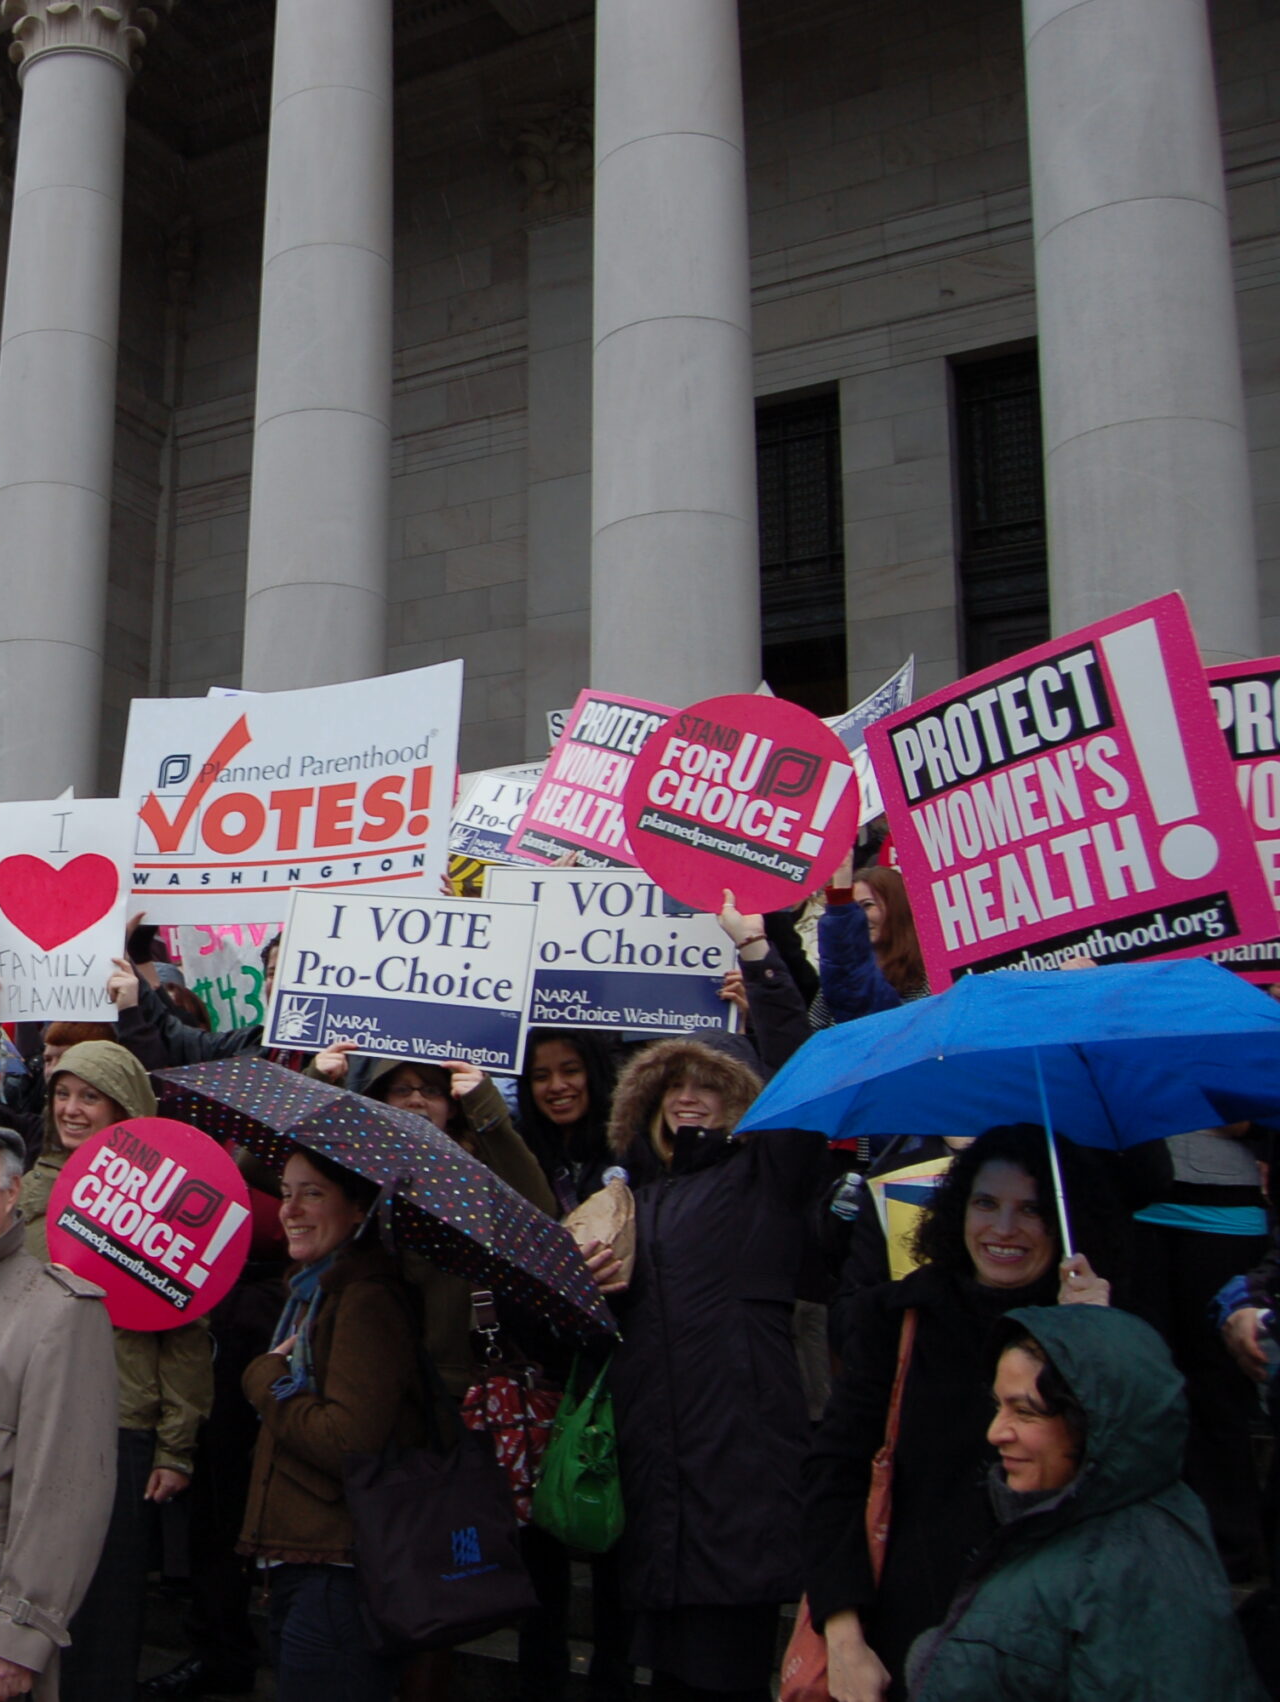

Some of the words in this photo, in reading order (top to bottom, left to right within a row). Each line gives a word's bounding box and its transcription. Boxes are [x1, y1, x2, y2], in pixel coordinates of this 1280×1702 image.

[572, 701, 669, 755] PROTEC
[674, 714, 740, 752] STAND
[892, 649, 1101, 800] PROTECT
[299, 735, 430, 777] Parenthood
[552, 743, 635, 797] WOMEN
[910, 735, 1130, 872] WOMEN'S
[49, 812, 73, 853] I
[638, 811, 807, 882] plannedparenthood.org
[133, 854, 425, 885] WASHINGTON
[570, 881, 694, 918] VOT
[327, 905, 347, 939] I
[370, 906, 491, 950] VOTE
[539, 928, 721, 969] o-Choice
[292, 950, 513, 1002] Pro-Choice
[534, 989, 591, 1004] NARAL
[326, 1013, 381, 1031] NARAL
[533, 1003, 620, 1023] Pro-Choice
[624, 1007, 722, 1029] Washington
[324, 1030, 409, 1053] Pro-Choice
[412, 1037, 510, 1064] Washington
[108, 1127, 161, 1171] STAND
[58, 1212, 190, 1308] plannedparenthood.org
